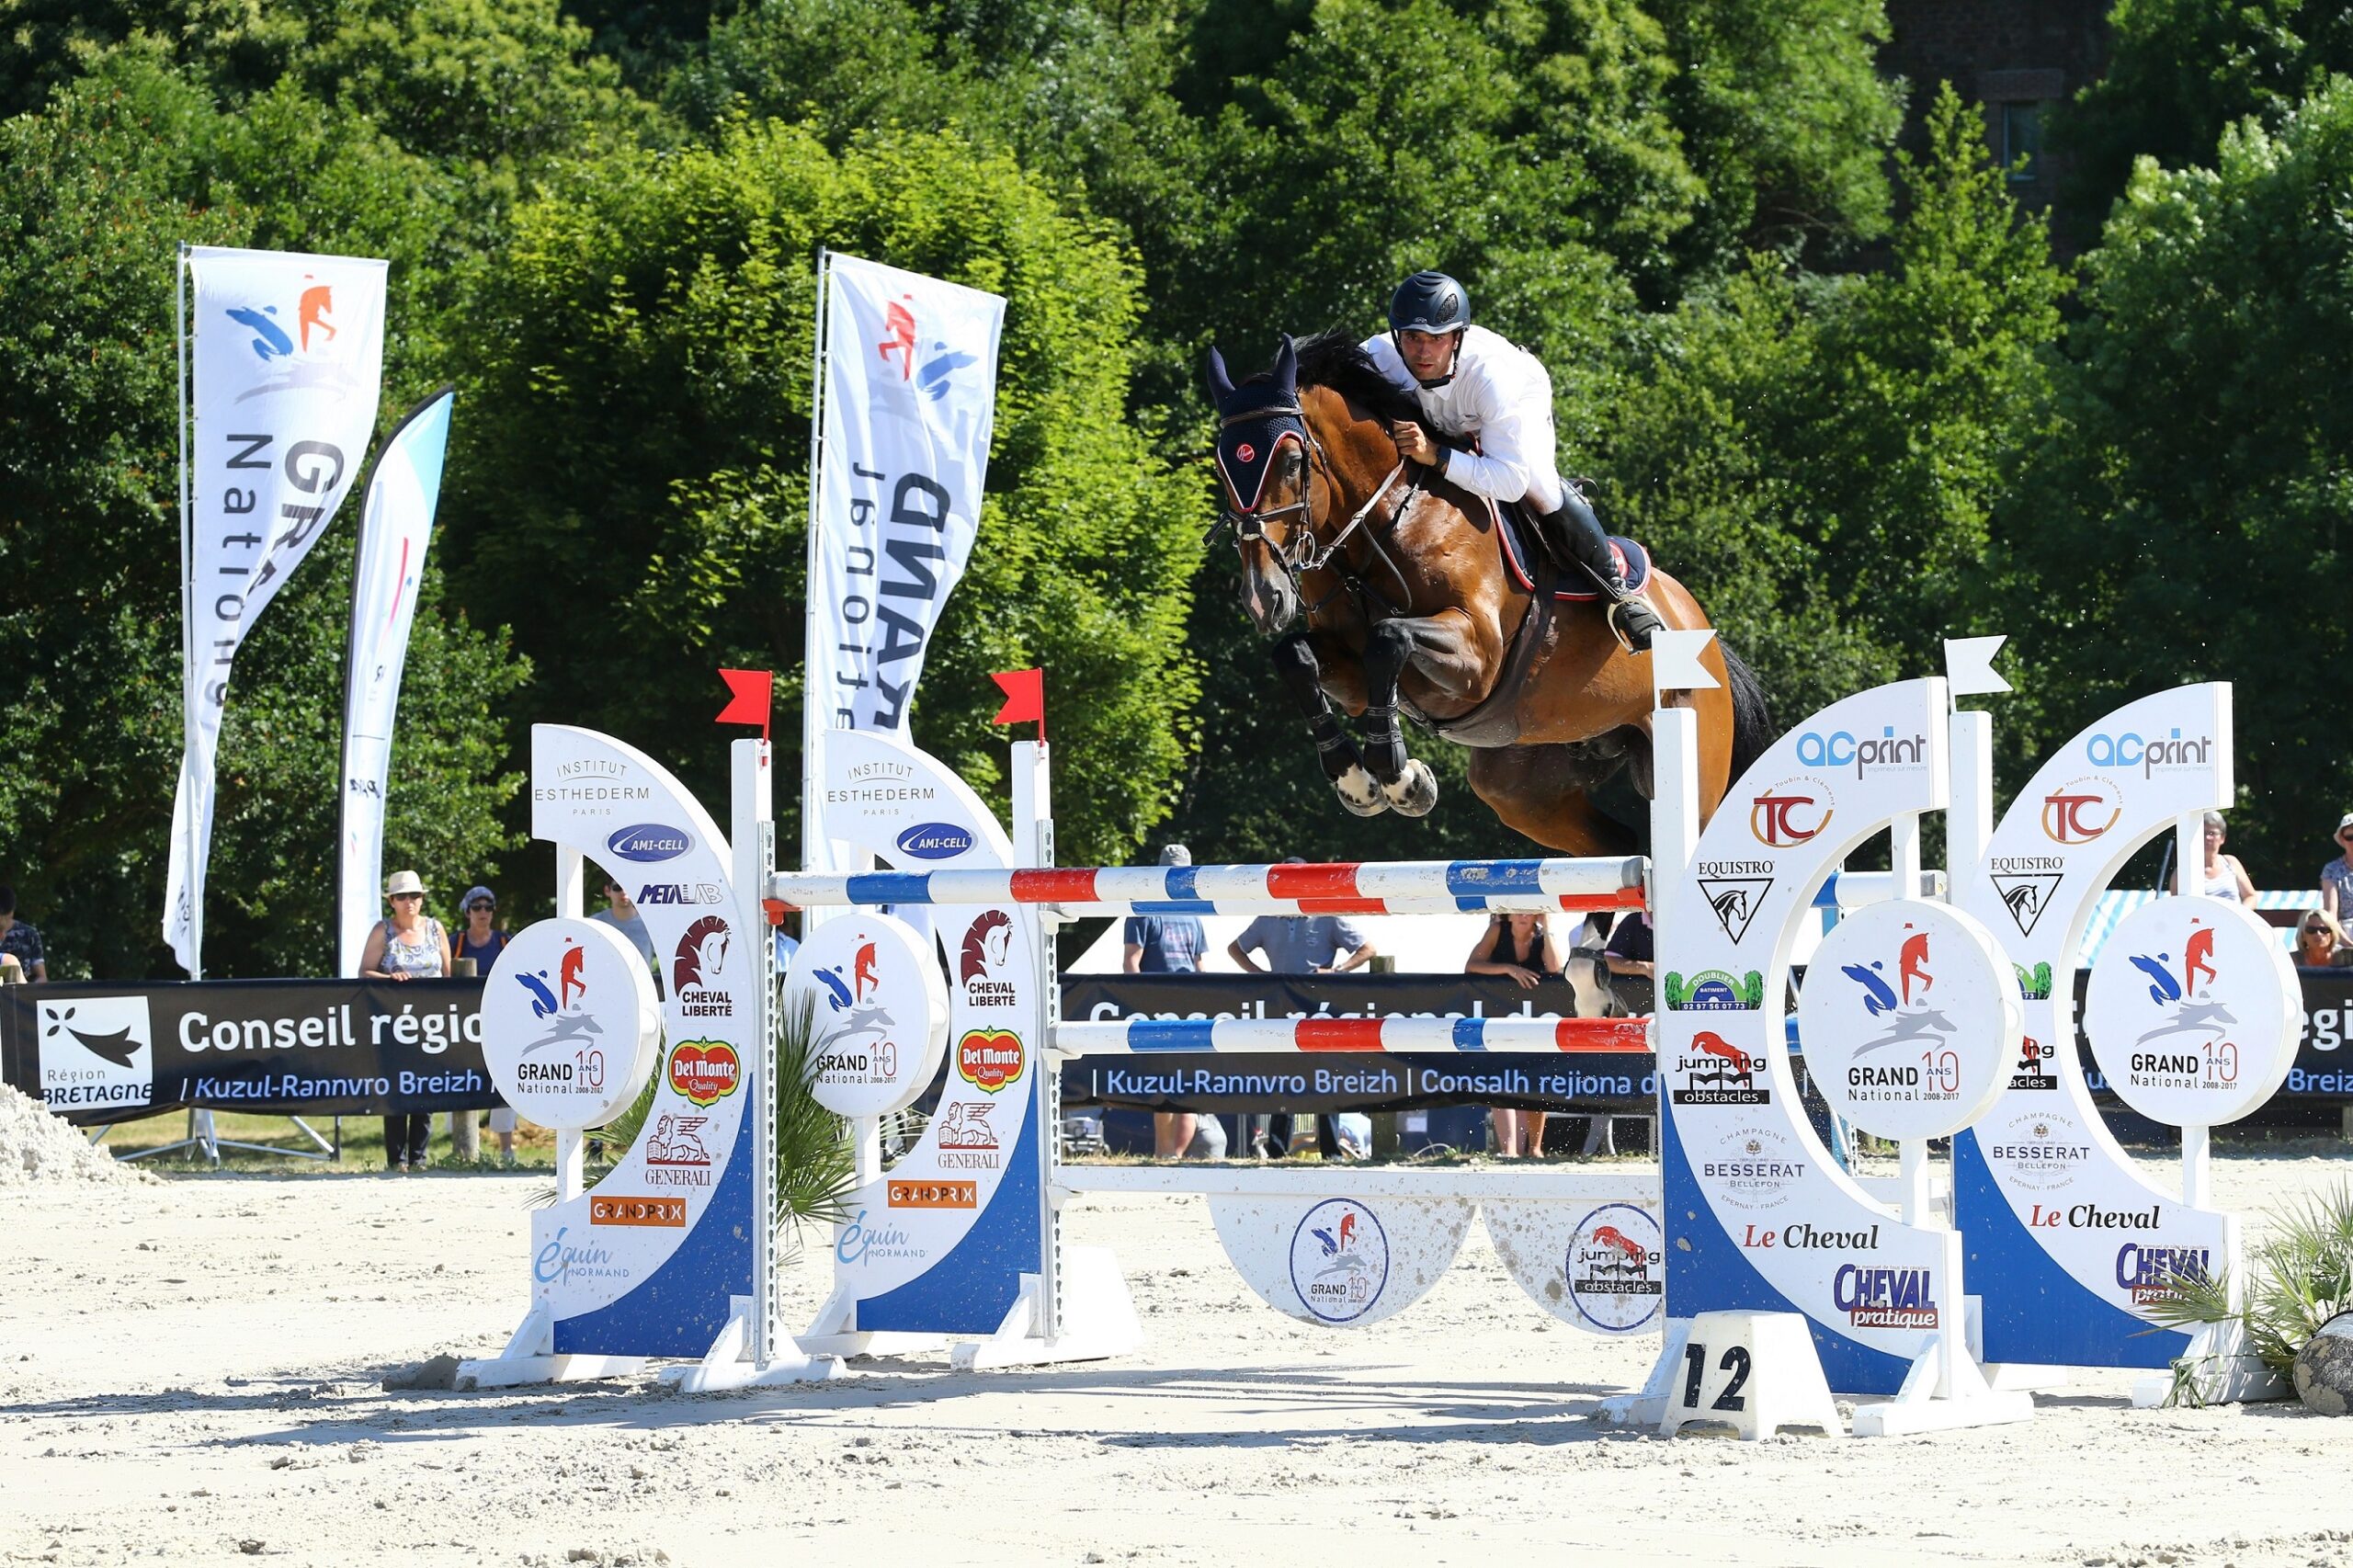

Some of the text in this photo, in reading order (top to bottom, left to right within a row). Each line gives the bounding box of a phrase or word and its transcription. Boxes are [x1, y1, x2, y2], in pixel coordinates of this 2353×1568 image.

[556, 760, 628, 778] INSTITUT
[847, 762, 914, 779] INSTITUT
[2065, 775, 2091, 788] Toubin
[534, 787, 650, 801] ESTHEDERM
[827, 788, 935, 802] ESTHEDERM
[1775, 776, 1802, 789] Toubin
[1813, 777, 1836, 806] Clément
[573, 808, 611, 816] PARIS
[863, 808, 900, 816] PARIS
[2045, 795, 2104, 841] TC
[1754, 797, 1816, 844] TC
[631, 839, 684, 851] AMI-CELL
[918, 836, 968, 849] AMI-CELL
[1698, 860, 1775, 878] EQUISTRO
[1991, 857, 2063, 874] EQUISTRO
[1692, 971, 1735, 987] DOUBLIER
[969, 983, 1016, 994] CHEVAL
[682, 991, 733, 1004] CHEVAL
[682, 1003, 733, 1017] LIBERTÉ
[178, 1004, 481, 1054] Conseil régio
[816, 1054, 868, 1071] GRAND
[870, 1041, 896, 1076] 10
[962, 1048, 1020, 1064] Del Monte
[1675, 1055, 1767, 1073] jumping
[2131, 1053, 2199, 1074] GRAND
[2202, 1041, 2237, 1082] 10
[48, 1068, 106, 1083] Région
[517, 1062, 573, 1081] GRAND
[575, 1050, 604, 1086] 10
[674, 1060, 735, 1077] Del Monte
[978, 1066, 1005, 1080] Quality
[1848, 1066, 1919, 1086] GRAND
[1922, 1051, 1959, 1092] 10
[1927, 1067, 1952, 1075] ANS
[194, 1069, 482, 1099] Kuzul-Rannvro Breizh
[689, 1079, 719, 1094] Quality
[816, 1073, 868, 1084] National
[1107, 1069, 1306, 1095] Kuzul-Rannvro
[1314, 1069, 1397, 1094] Breizh
[1421, 1068, 1529, 1095] Consalh
[1539, 1070, 1631, 1099] rejiona
[2131, 1074, 2198, 1088] National
[2202, 1081, 2237, 1090] 2008-2017
[41, 1083, 153, 1105] BRETAGNE
[517, 1083, 572, 1095] National
[1684, 1090, 1759, 1103] obstacles
[1848, 1088, 1919, 1101] National
[1923, 1092, 1960, 1101] 2008-2017
[2008, 1112, 2074, 1129] CHAMPAGNE
[1720, 1128, 1787, 1145] CHAMPAGNE
[938, 1153, 1000, 1169] GENERALI
[1994, 1146, 2090, 1160] BESSERAT
[645, 1170, 711, 1187] GENERALI
[1704, 1164, 1805, 1177] BESSERAT
[2009, 1176, 2074, 1191] EPERNAY FRANCE
[1721, 1194, 1789, 1210] EPERNAY FRANCE
[2029, 1204, 2160, 1229] Le Cheval
[1744, 1223, 1879, 1249] Le Cheval
[870, 1248, 926, 1258] NORMAND
[571, 1268, 630, 1278] NORMAND
[1311, 1284, 1347, 1295] GRAND
[1585, 1280, 1653, 1292] obstacles
[1834, 1264, 1936, 1312] CHEVAL
[1311, 1295, 1346, 1303] National
[1853, 1308, 1936, 1332] pratique
[1683, 1343, 1752, 1412] 12
